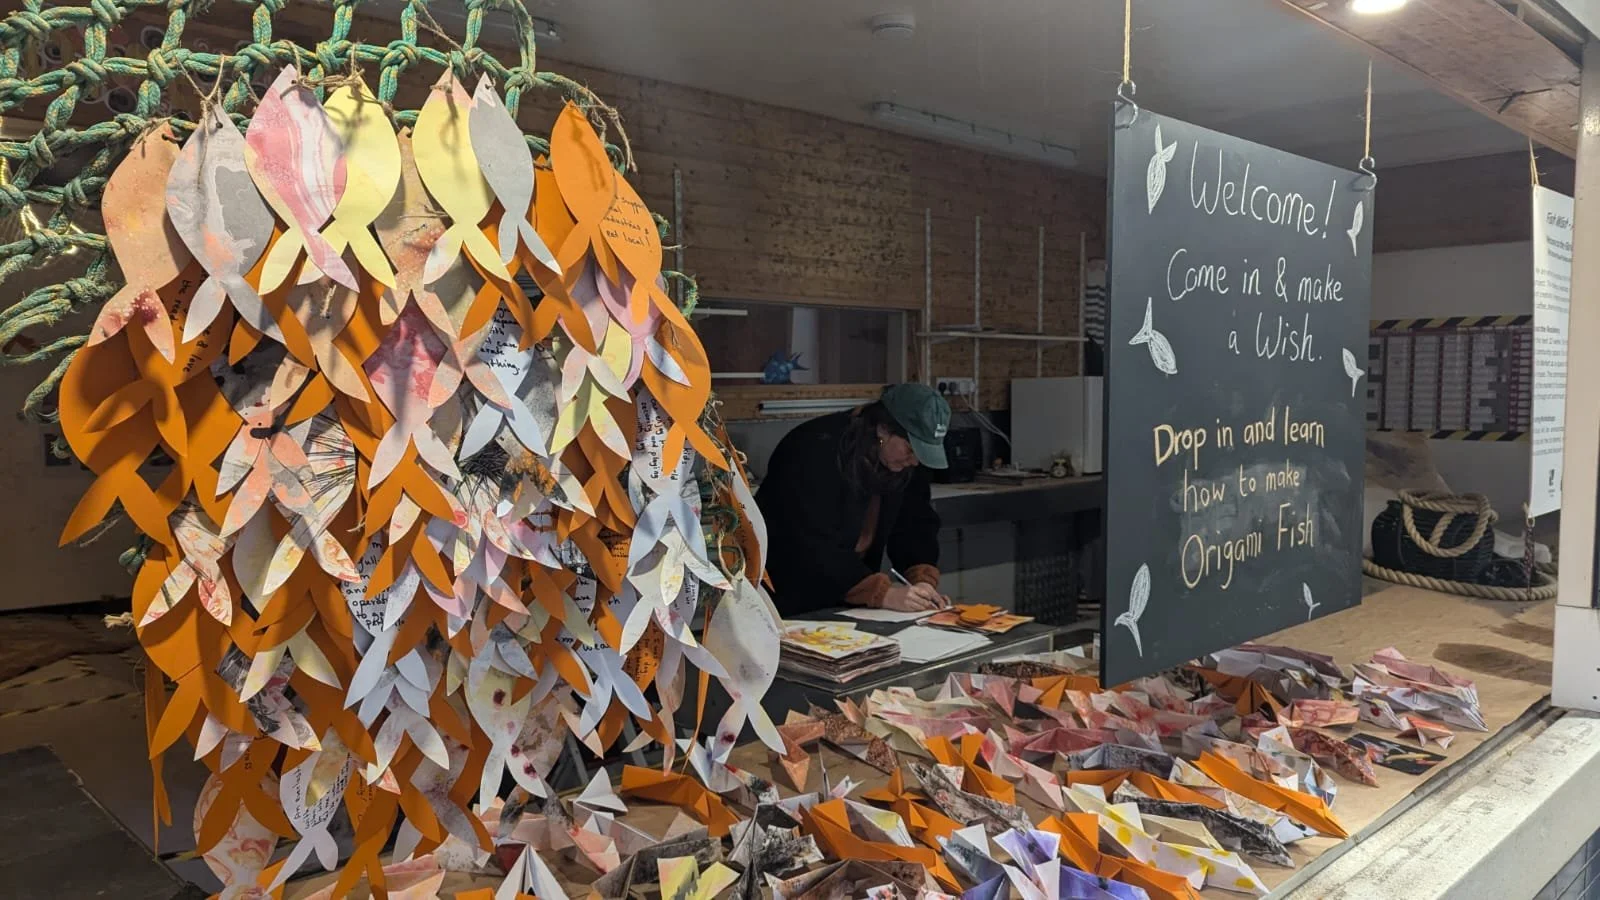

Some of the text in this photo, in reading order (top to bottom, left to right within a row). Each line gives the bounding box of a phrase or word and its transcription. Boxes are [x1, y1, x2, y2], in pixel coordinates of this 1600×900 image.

[1191, 141, 1336, 239] Welcome!
[1167, 249, 1344, 303] Come in & make
[1229, 312, 1322, 362] a Wish.
[1153, 406, 1324, 471] Drop in and learn
[1184, 459, 1300, 512] how to make
[1182, 503, 1314, 589] Origami Fish
